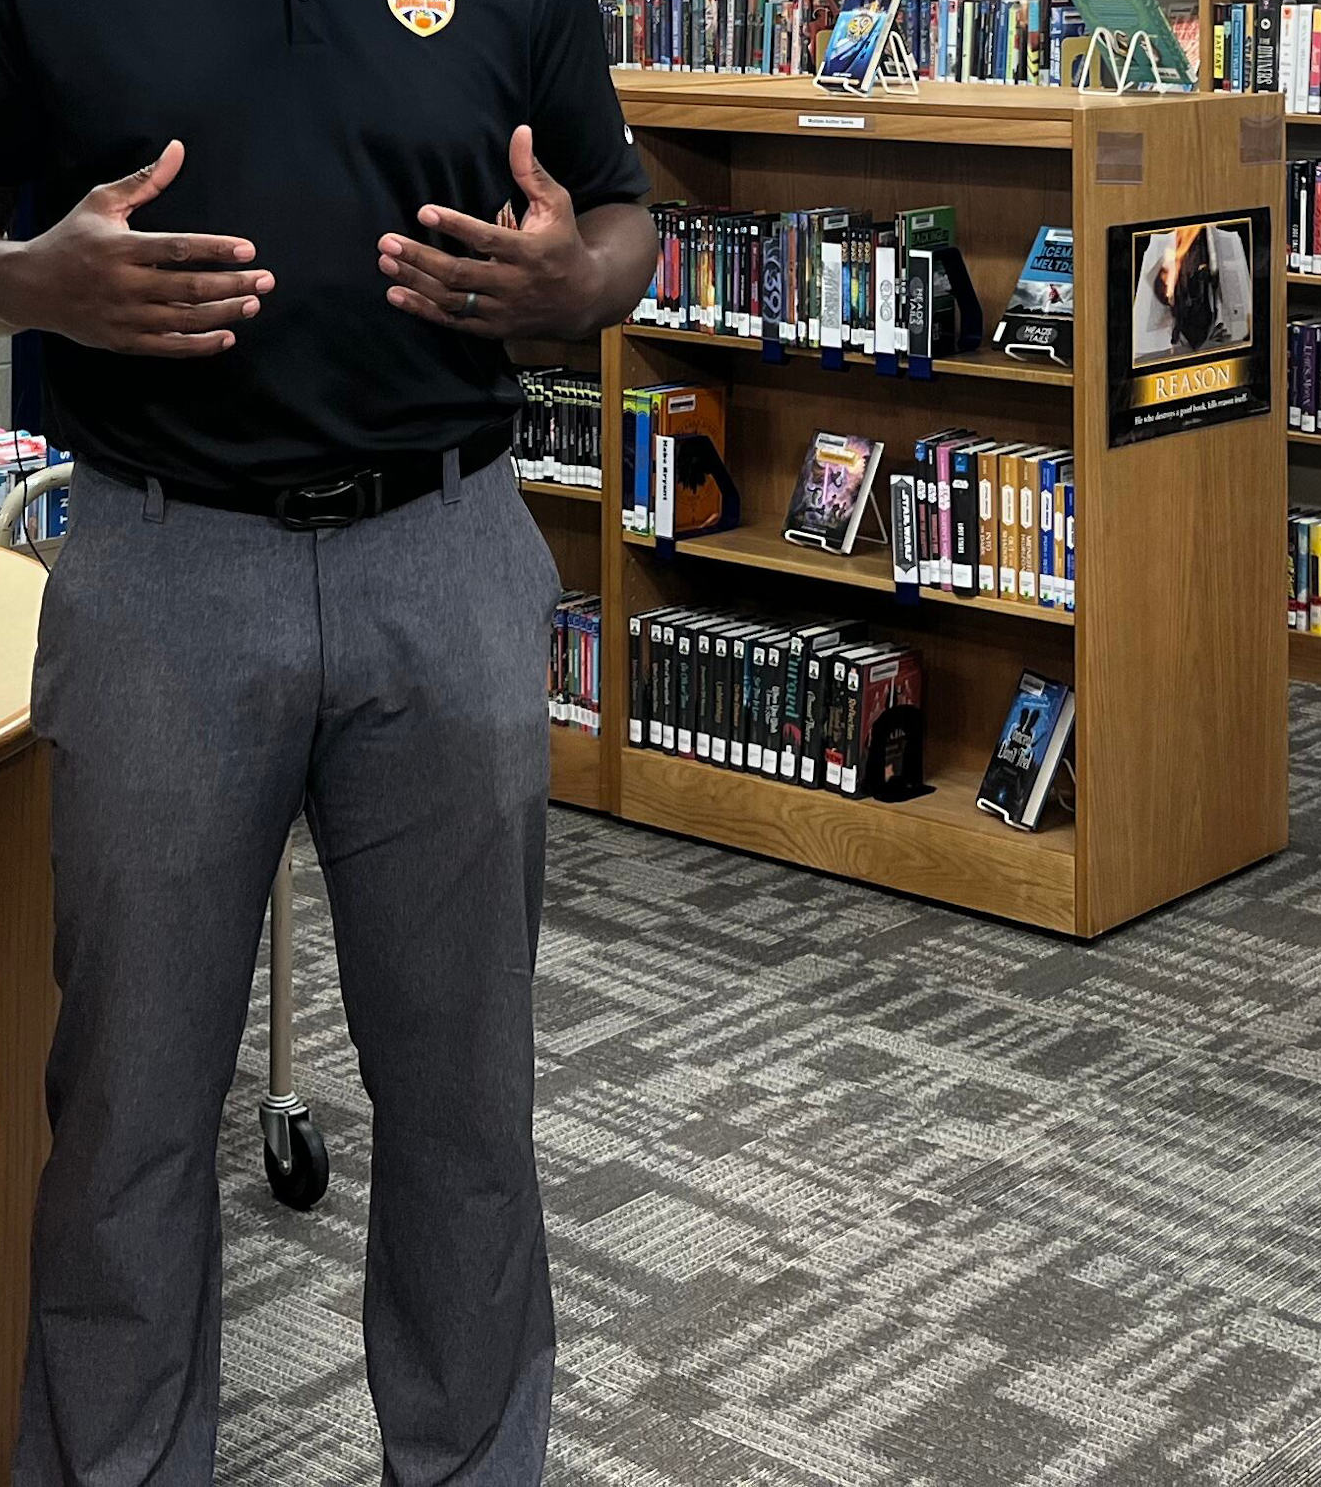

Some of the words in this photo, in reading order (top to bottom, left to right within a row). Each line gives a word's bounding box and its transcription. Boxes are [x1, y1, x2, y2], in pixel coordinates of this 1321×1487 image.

[1257, 45, 1273, 85] DIVINERS
[1156, 365, 1230, 399] REASON
[902, 489, 911, 525] STAR
[903, 526, 913, 562] WARS
[785, 656, 800, 719] ursed
